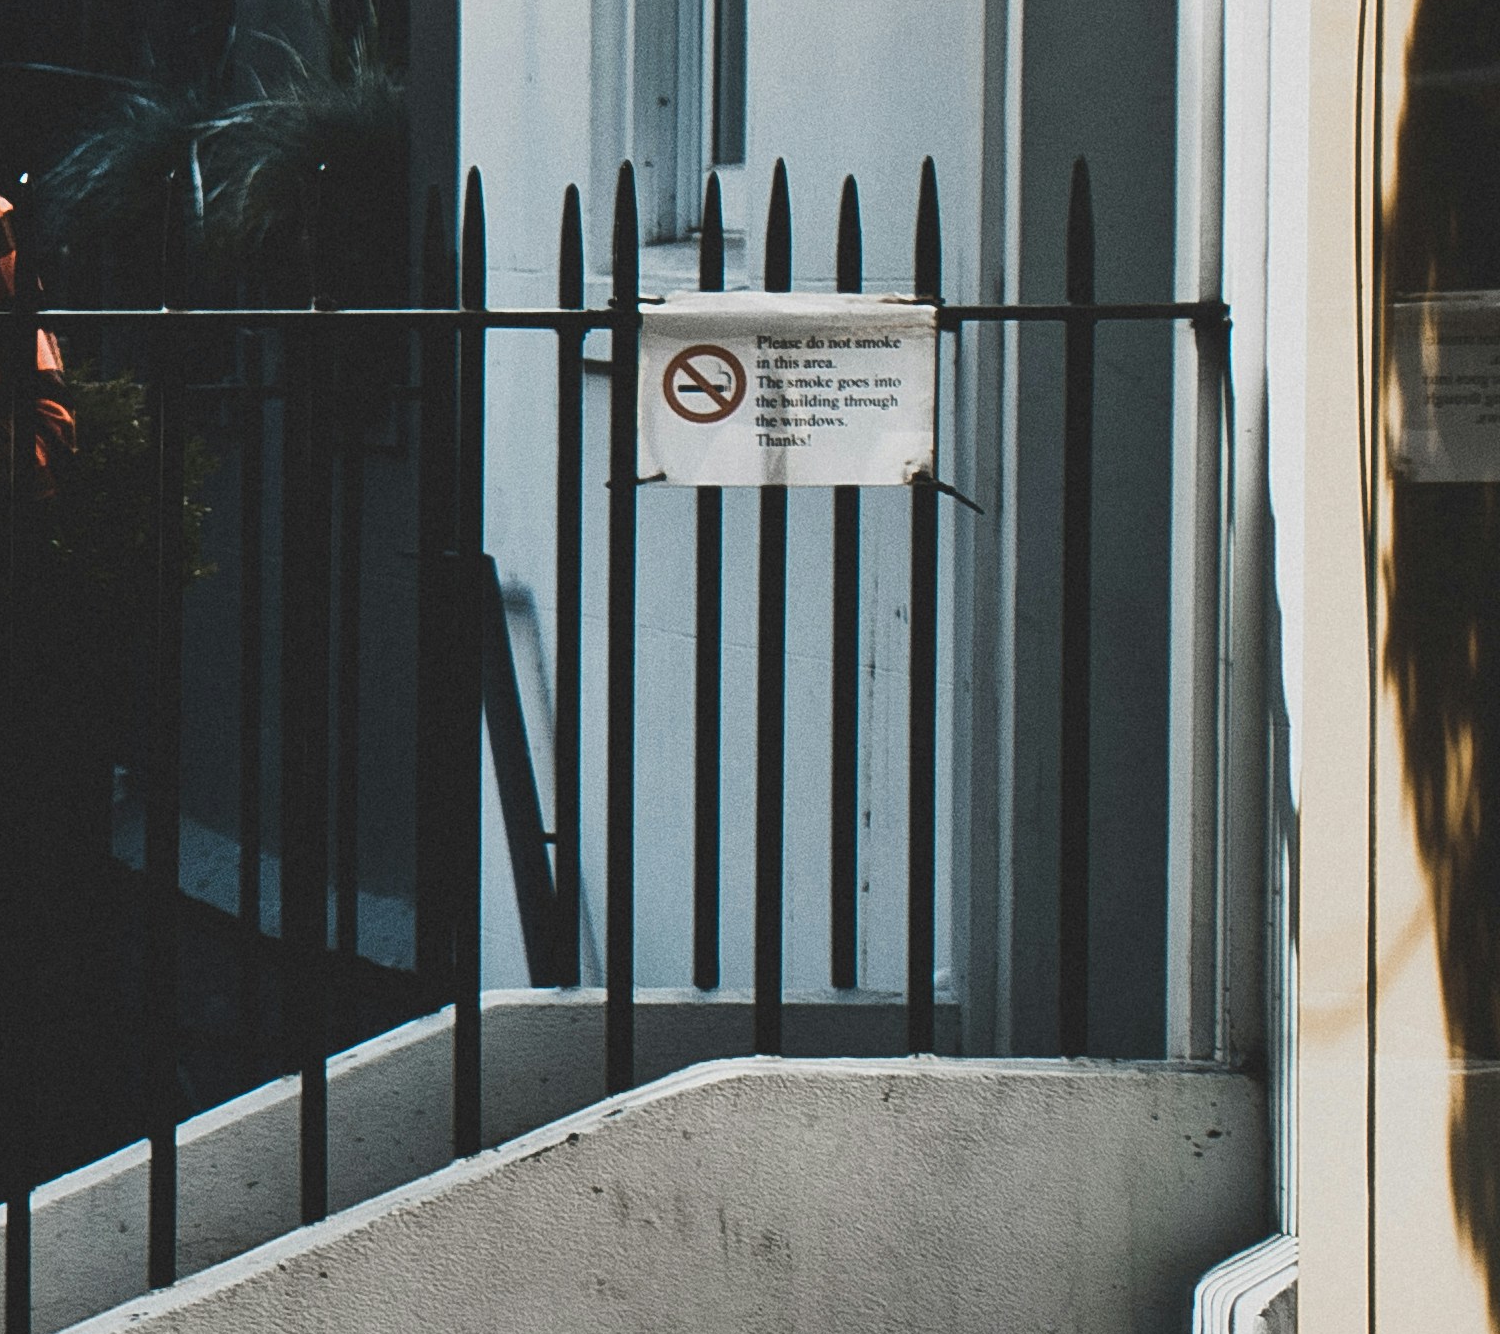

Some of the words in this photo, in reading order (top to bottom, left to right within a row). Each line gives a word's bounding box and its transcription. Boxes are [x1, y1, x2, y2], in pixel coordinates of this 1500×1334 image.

[756, 335, 802, 350] Please
[806, 335, 825, 349] do
[828, 336, 852, 349] not
[855, 335, 902, 349] smoke
[756, 355, 770, 369] in
[774, 355, 800, 369] this
[803, 358, 837, 369] area.
[756, 375, 784, 389] The
[787, 375, 834, 389] smoke
[837, 377, 870, 391] goes
[874, 374, 902, 388] into
[755, 394, 778, 409] the
[781, 394, 840, 410] building
[844, 394, 899, 410] through
[755, 414, 778, 427] the
[781, 414, 848, 427] windows.
[756, 433, 812, 447] Thanks!
